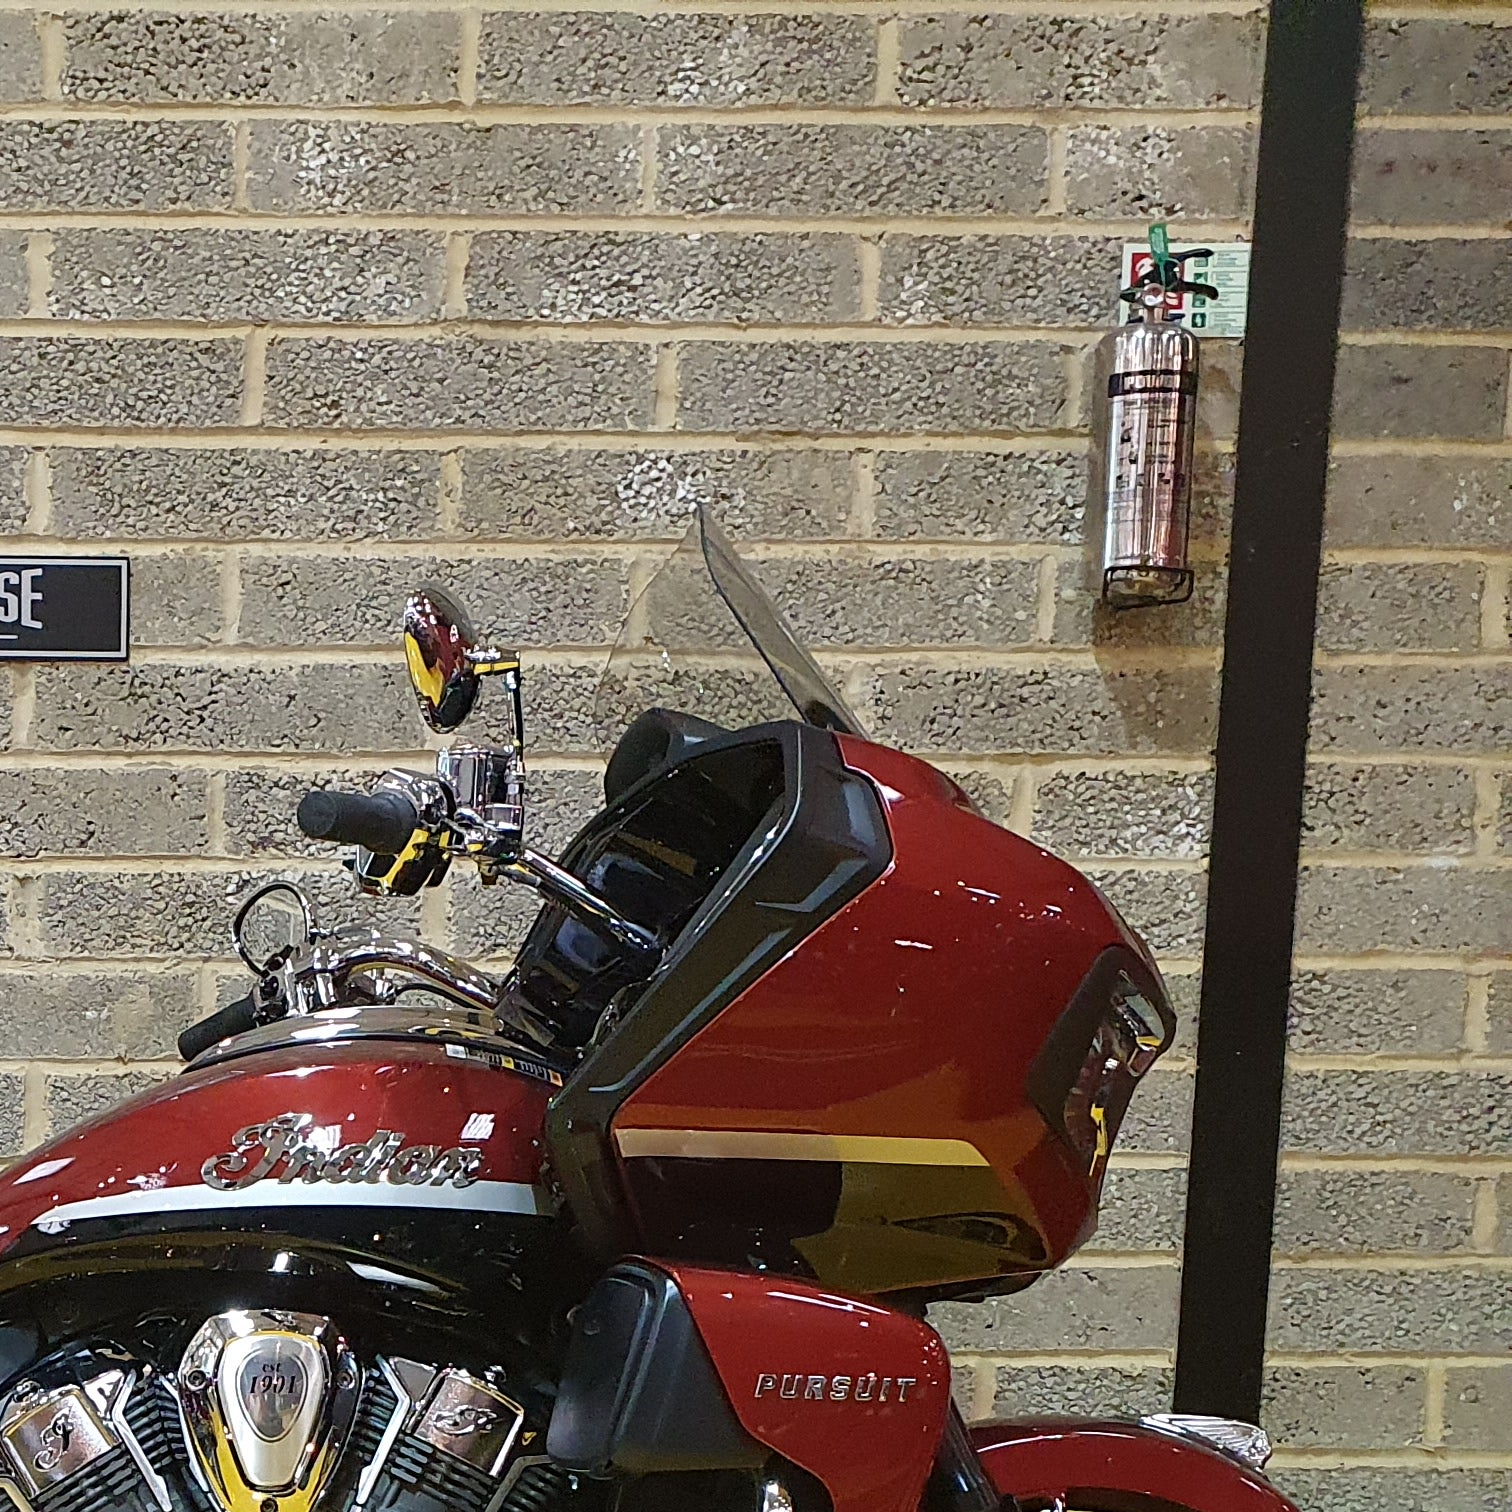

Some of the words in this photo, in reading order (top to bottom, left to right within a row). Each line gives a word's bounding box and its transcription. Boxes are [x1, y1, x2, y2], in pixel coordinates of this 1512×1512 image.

[200, 1112, 483, 1191] Indian
[249, 1375, 296, 1394] 1901
[754, 1372, 917, 1403] PURSUIT
